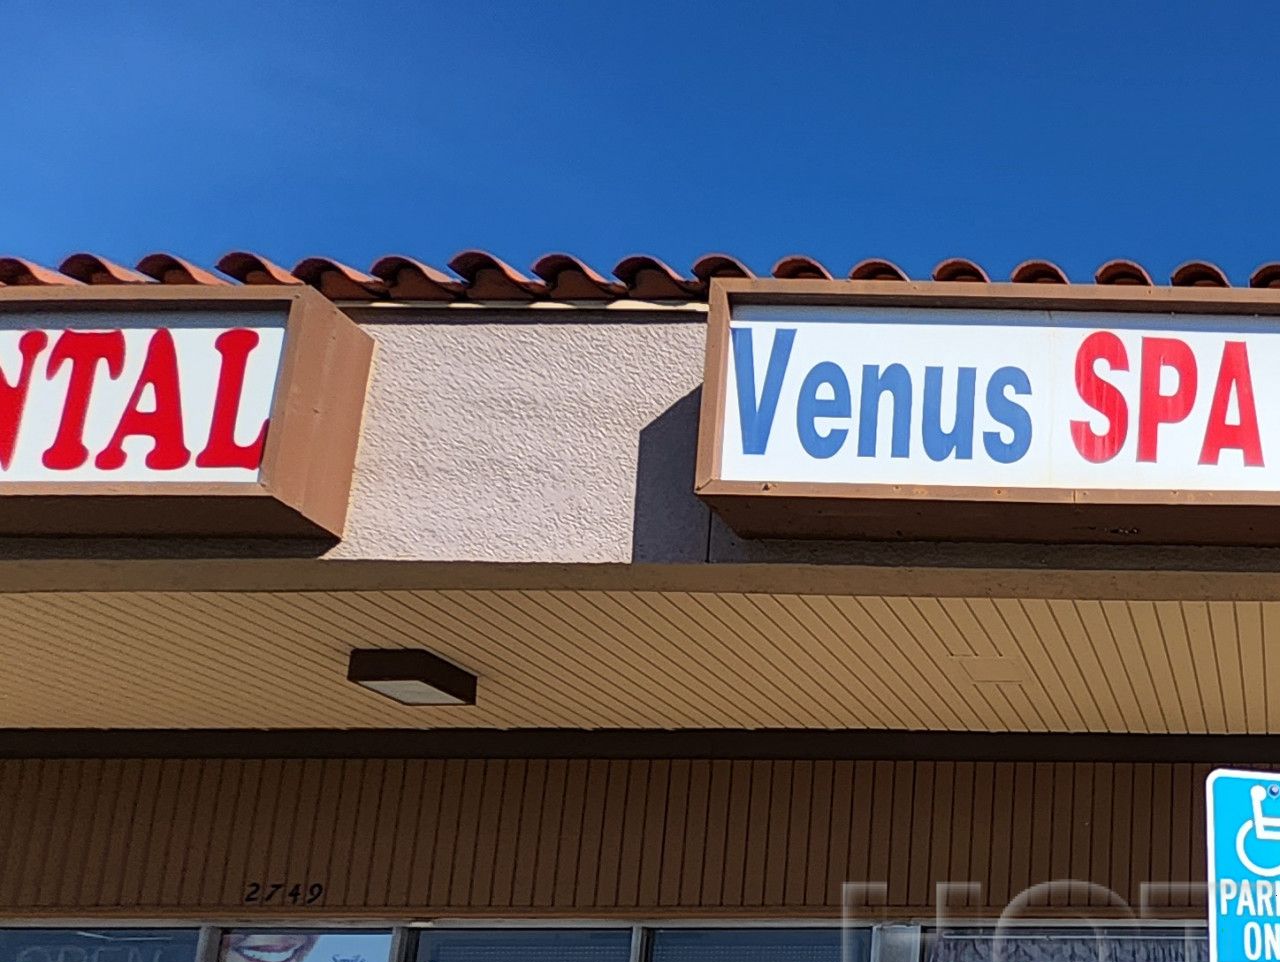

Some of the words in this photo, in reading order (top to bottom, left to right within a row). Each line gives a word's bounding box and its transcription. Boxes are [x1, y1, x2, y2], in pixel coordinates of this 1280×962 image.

[731, 327, 1033, 464] Venus
[1070, 331, 1265, 468] SPA
[244, 882, 324, 904] 2749
